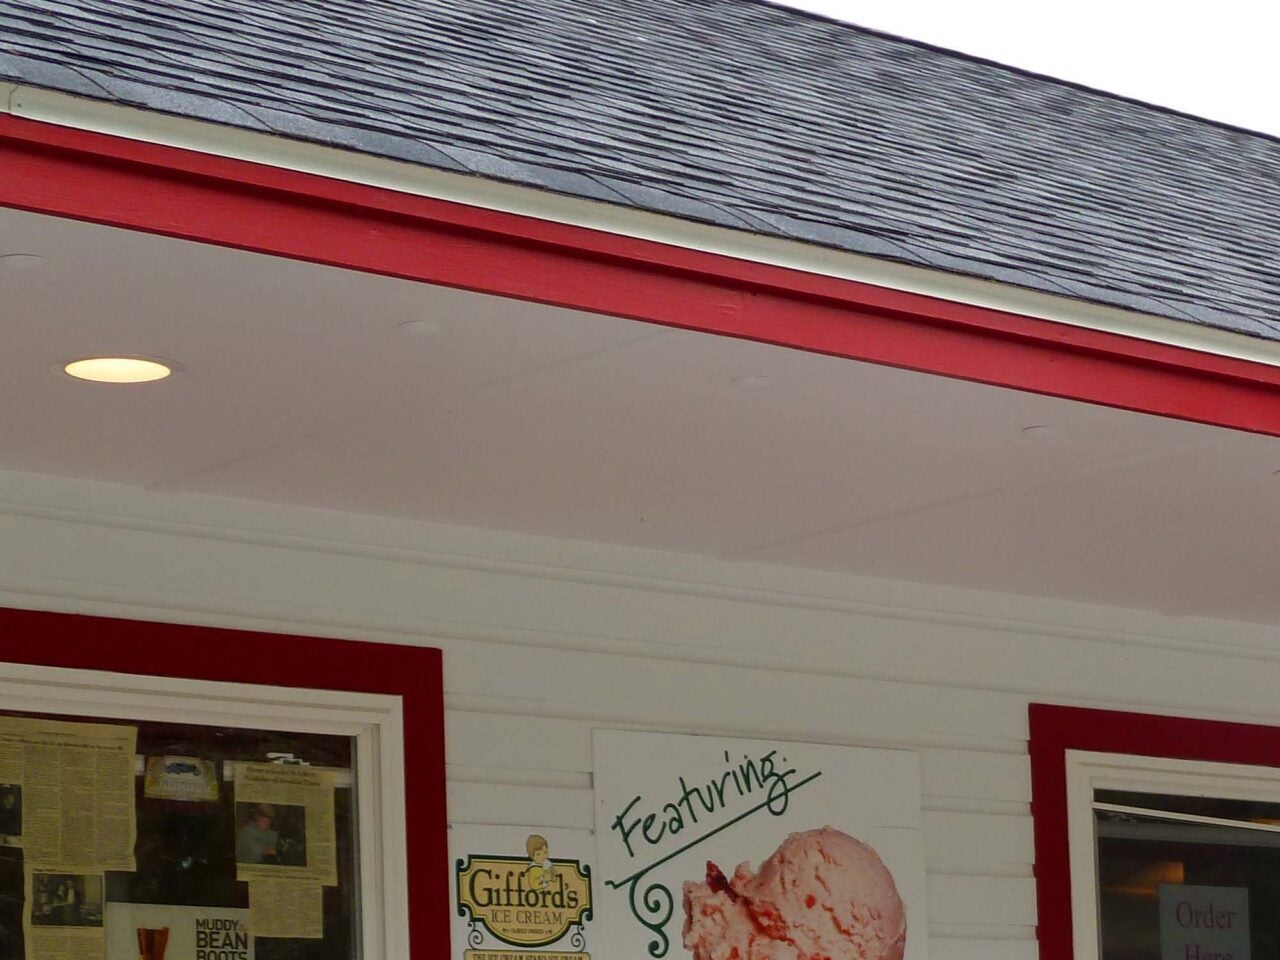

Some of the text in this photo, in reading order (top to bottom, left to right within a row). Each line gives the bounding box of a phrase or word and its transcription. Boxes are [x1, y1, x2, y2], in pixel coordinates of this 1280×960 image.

[612, 750, 796, 857] Featuring
[469, 868, 579, 909] Gifford's
[196, 919, 239, 931] MUDDY
[491, 909, 563, 925] ICE CREAM
[1175, 901, 1236, 929] Order
[196, 931, 248, 950] BEAN
